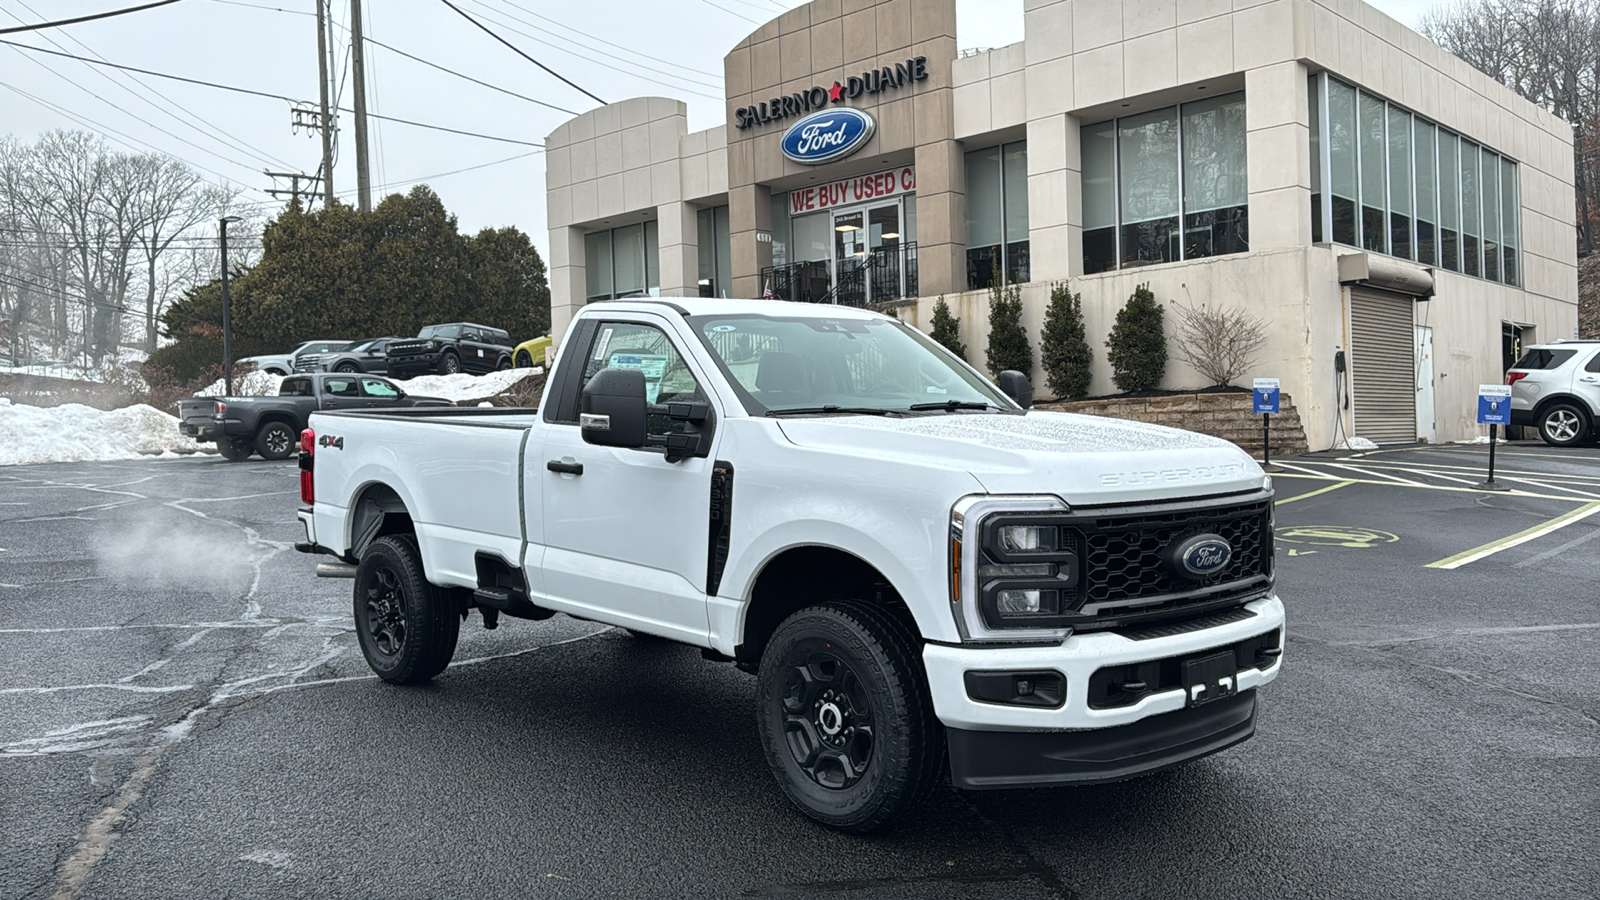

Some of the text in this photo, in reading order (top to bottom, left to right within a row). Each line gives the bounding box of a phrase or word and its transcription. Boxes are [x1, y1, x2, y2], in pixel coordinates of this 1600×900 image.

[735, 56, 929, 130] SALERNO DUANE
[797, 119, 848, 154] Ford
[791, 188, 815, 212] WE
[819, 181, 849, 208] BUY
[853, 171, 896, 201] USED
[1196, 546, 1222, 567] Ford
